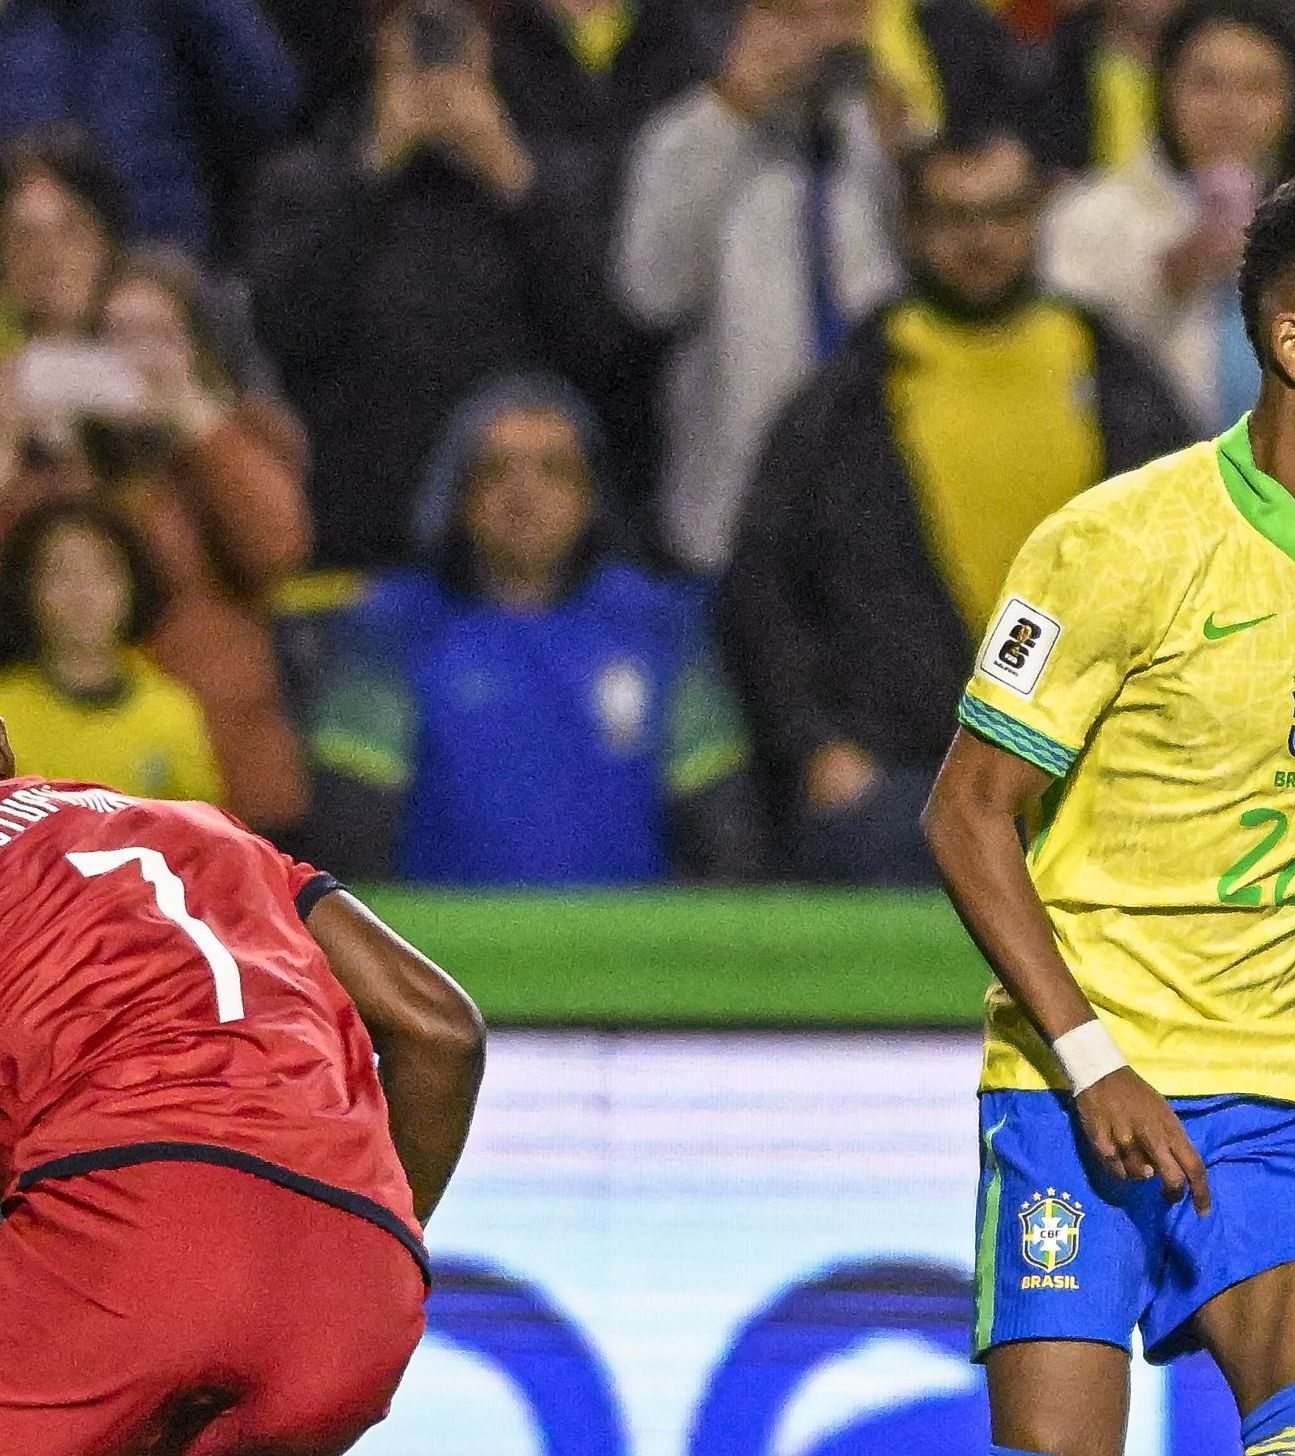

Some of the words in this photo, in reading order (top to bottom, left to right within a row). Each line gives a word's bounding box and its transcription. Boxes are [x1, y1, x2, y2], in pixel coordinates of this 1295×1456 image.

[65, 846, 245, 1024] 7
[1040, 1229, 1061, 1239] CBF
[1021, 1274, 1080, 1291] BRASIL
